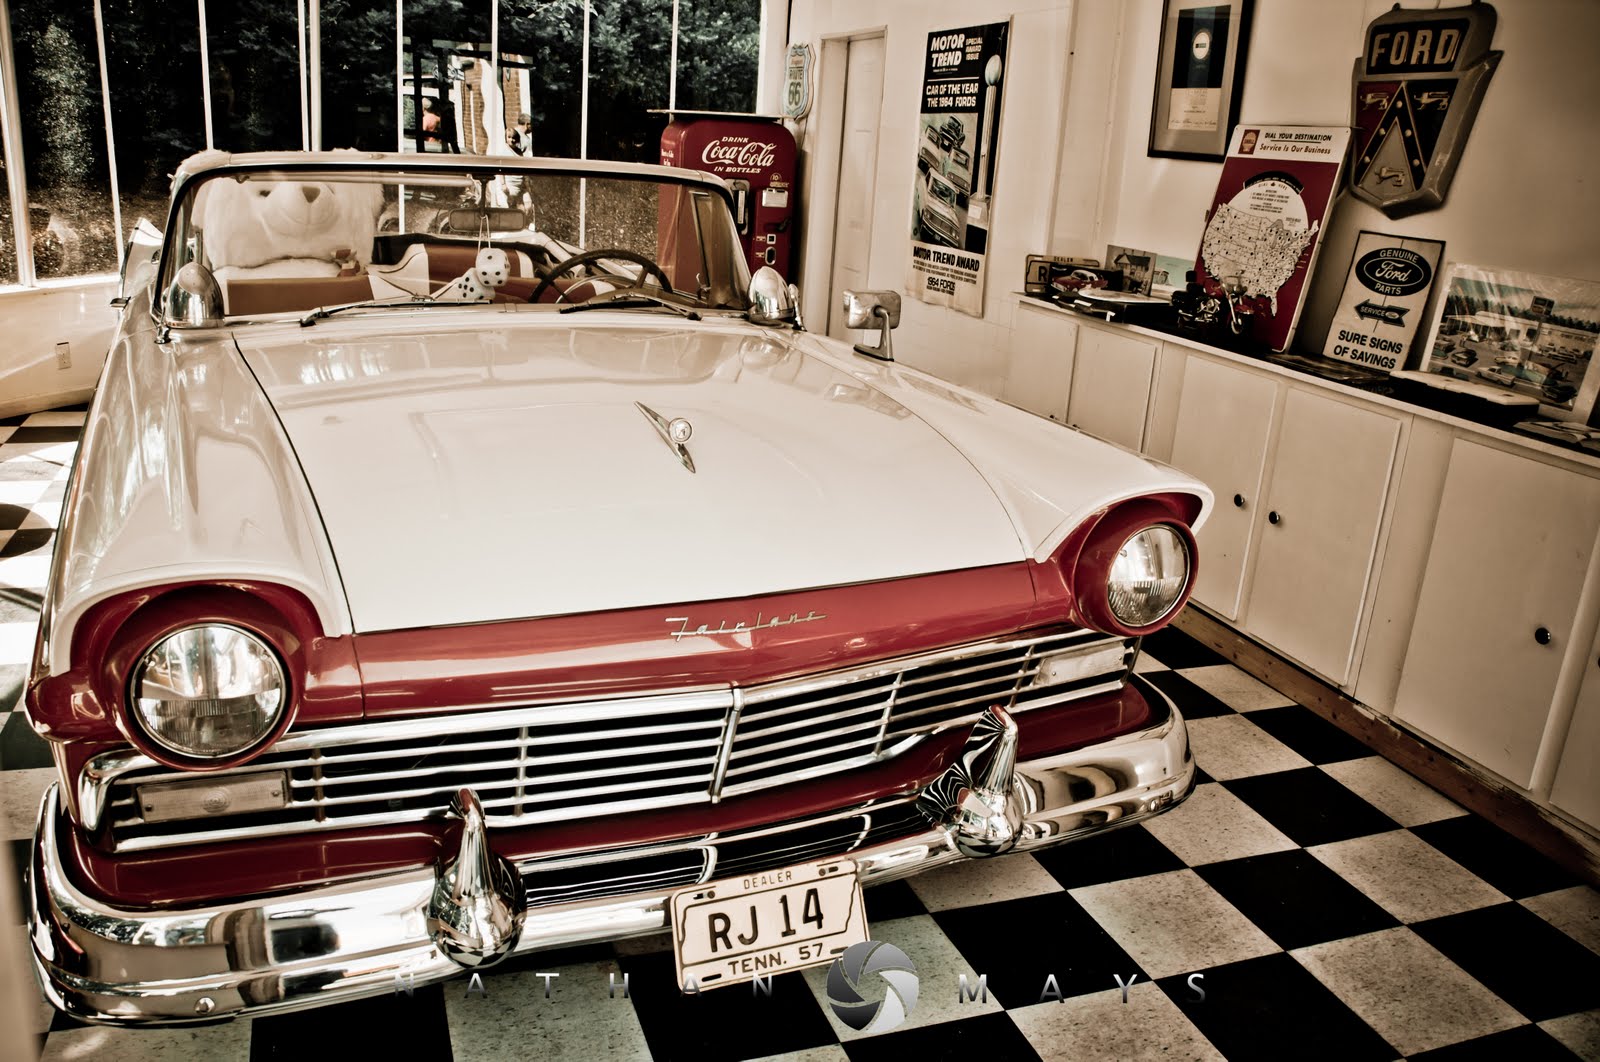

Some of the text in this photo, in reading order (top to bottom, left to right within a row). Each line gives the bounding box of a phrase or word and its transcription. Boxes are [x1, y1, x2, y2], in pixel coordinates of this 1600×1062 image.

[931, 33, 965, 51] MOTOR
[965, 37, 983, 45] SPECIAL
[1370, 29, 1461, 67] FORD
[931, 51, 962, 67] TREND
[966, 52, 979, 60] ISSUE
[788, 81, 802, 106] 66
[926, 82, 979, 95] CAR OF THE YEAR
[927, 96, 976, 107] THE 1964 FORDS
[1278, 132, 1293, 140] YOUR
[1295, 133, 1333, 141] DESTINATION
[702, 140, 777, 167] Coca-Cola
[1260, 143, 1331, 155] Service Is Our Business
[913, 246, 931, 261] MOTOR
[932, 250, 955, 267] TREND
[956, 255, 980, 272] AWARD
[1380, 249, 1419, 263] GENUINE
[1375, 260, 1412, 282] Ford
[927, 276, 939, 287] 1964
[1375, 283, 1402, 295] PARTS
[1360, 305, 1385, 317] SERVICE
[1338, 330, 1403, 354] SURE SIGNS
[1333, 345, 1396, 370] OF SAVINGS
[665, 610, 827, 641] Fairlane
[743, 870, 793, 890] DEALER
[708, 888, 824, 953] RJ 14
[728, 943, 823, 975] TENN. 57
